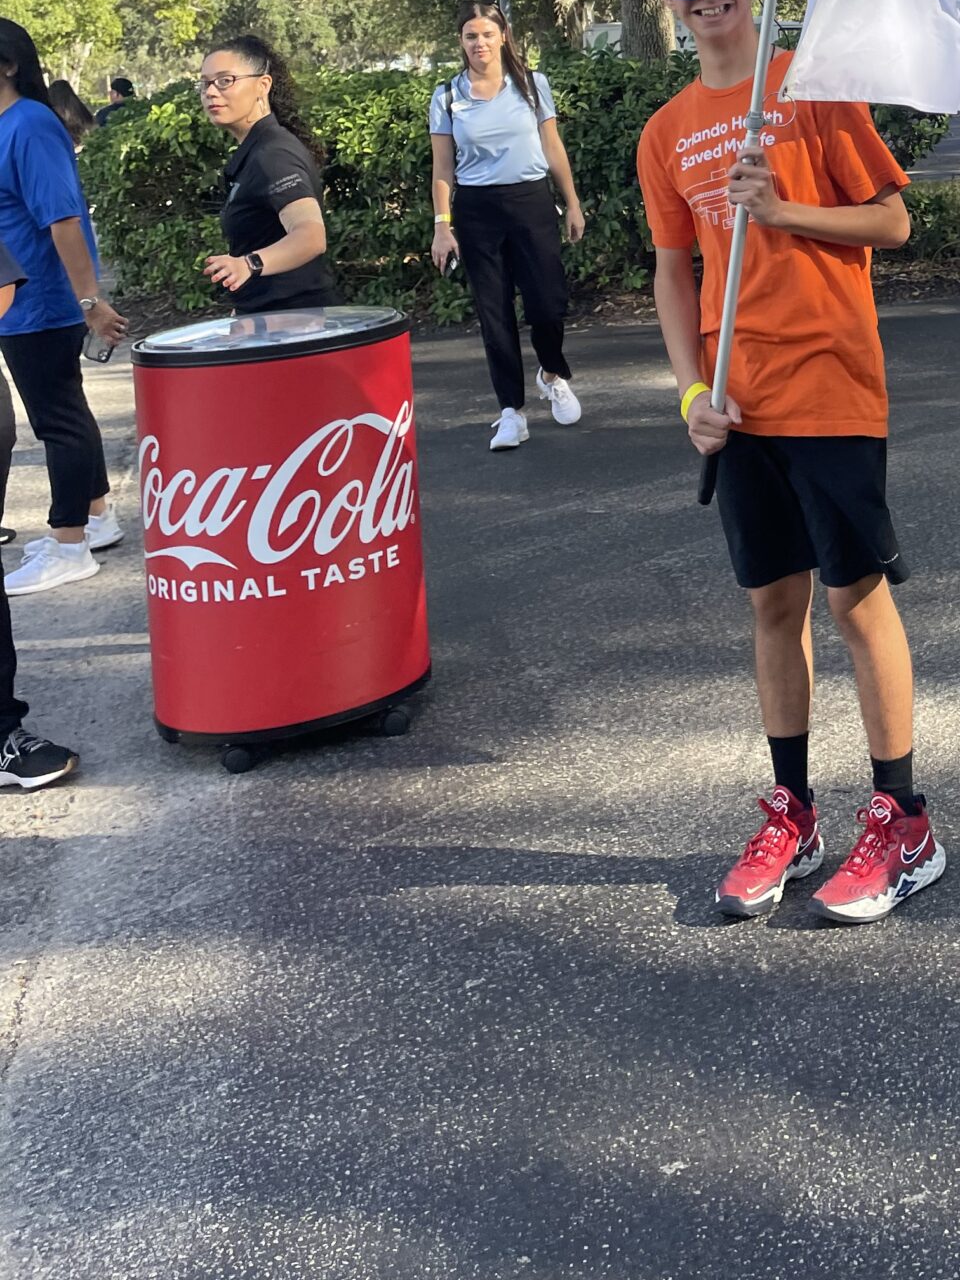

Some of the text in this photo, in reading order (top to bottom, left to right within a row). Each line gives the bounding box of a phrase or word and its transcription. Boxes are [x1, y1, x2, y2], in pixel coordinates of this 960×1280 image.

[675, 122, 728, 153] Orlando
[681, 143, 722, 171] Saved
[148, 544, 401, 603] ORIGINAL TASTE
